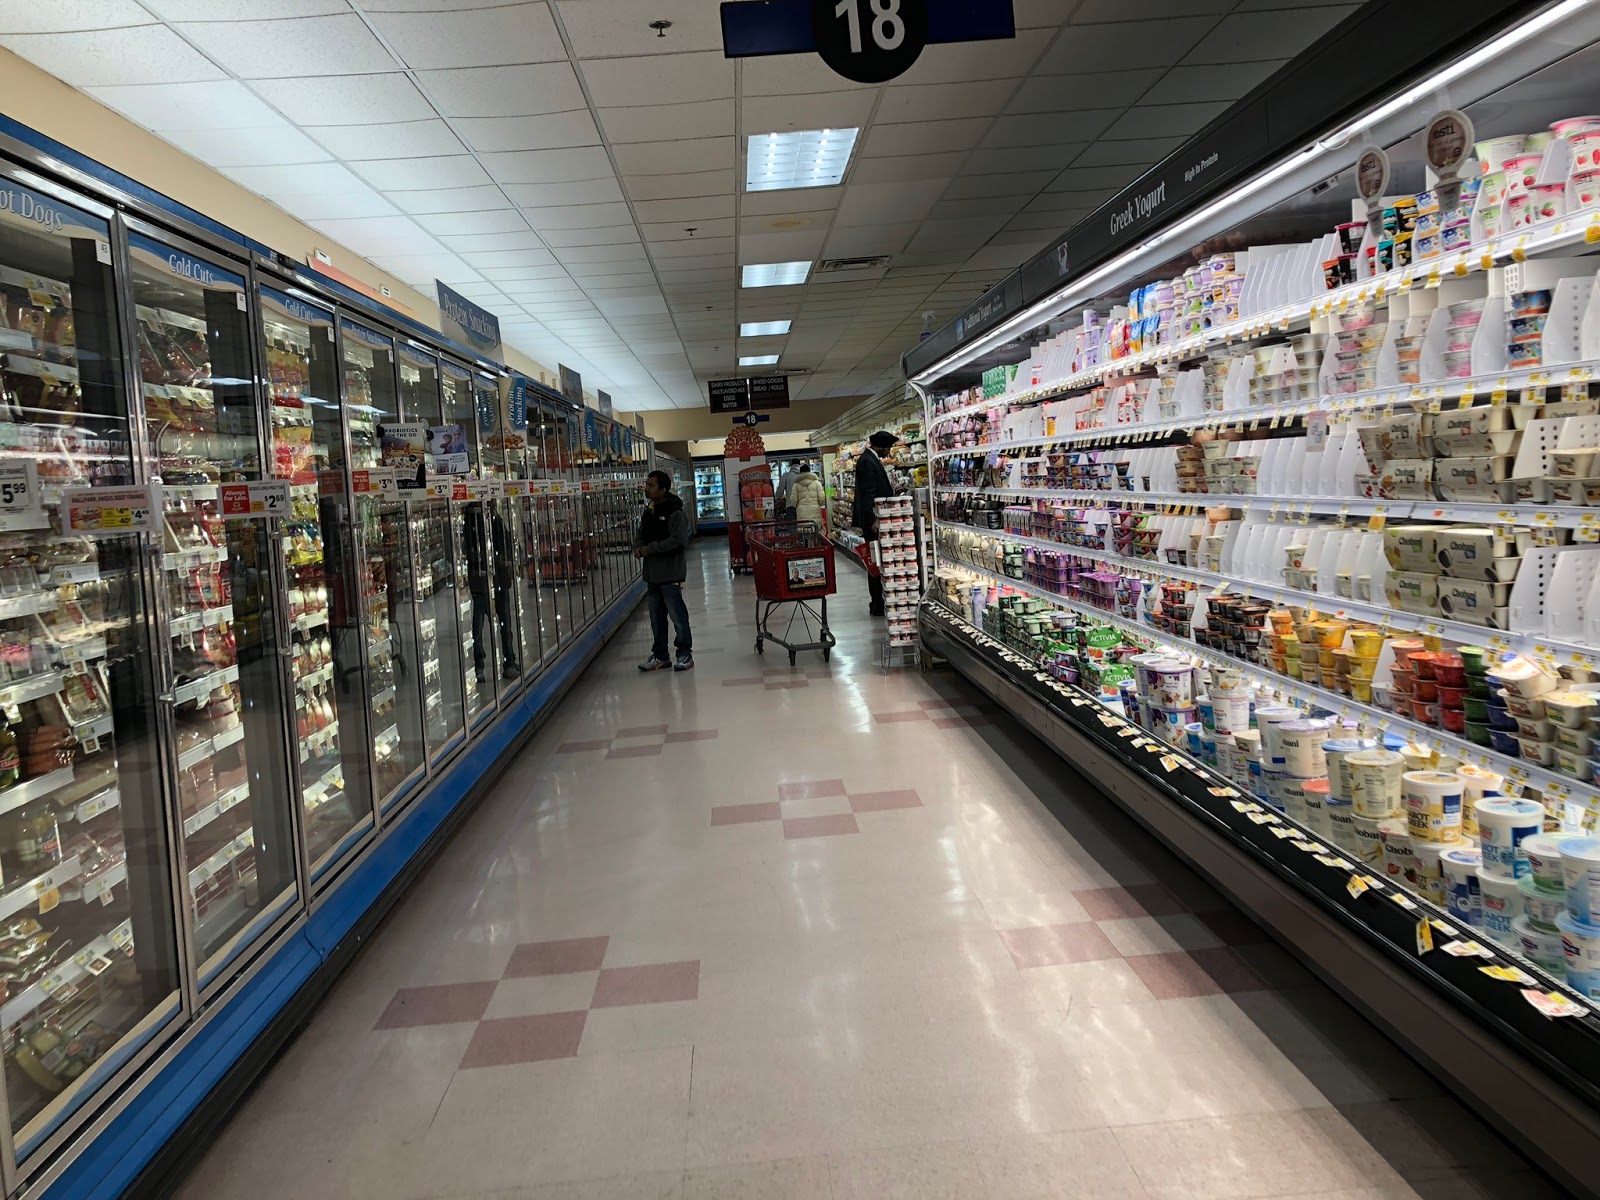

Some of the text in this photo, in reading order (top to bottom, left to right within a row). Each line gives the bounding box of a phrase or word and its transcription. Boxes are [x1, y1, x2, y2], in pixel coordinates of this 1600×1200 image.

[836, 0, 905, 53] 18
[1184, 167, 1195, 182] High
[1200, 152, 1218, 171] Protein
[0, 189, 62, 233] ot Dogs
[1110, 181, 1165, 236] Greek Yogurt
[169, 254, 214, 286] Cold Cuts
[285, 299, 314, 323] Cold Cuts
[444, 292, 498, 347] Protein Snacking
[515, 386, 524, 425] Snacking
[746, 415, 756, 424] 18
[1089, 634, 1116, 643] ACTIVIA
[1104, 673, 1131, 682] ACTIVIA
[1283, 739, 1299, 748] bani
[1284, 788, 1304, 797] obani
[1305, 799, 1321, 809] bani
[1329, 812, 1354, 824] oban
[1385, 844, 1413, 856] Chob
